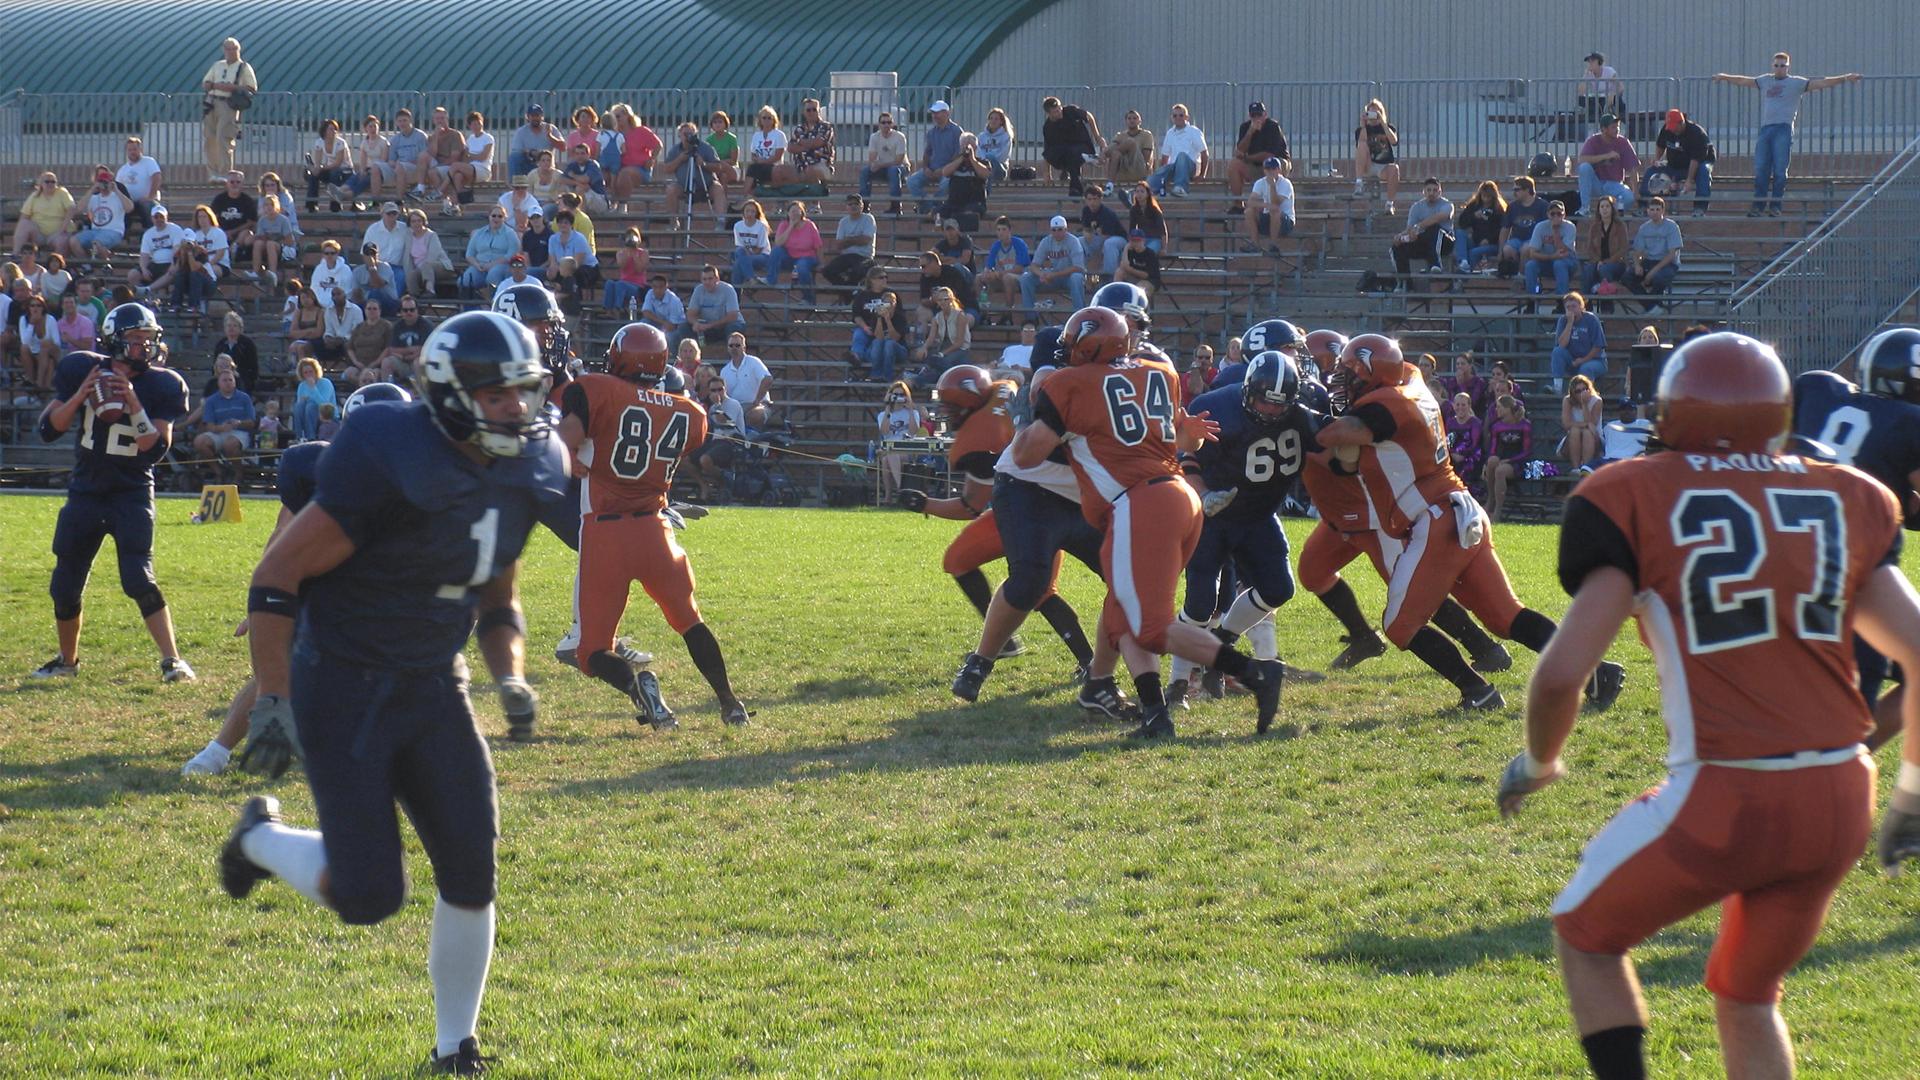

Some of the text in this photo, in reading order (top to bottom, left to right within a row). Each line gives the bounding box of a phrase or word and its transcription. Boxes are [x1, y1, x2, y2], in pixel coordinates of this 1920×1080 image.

[755, 148, 774, 158] NY
[757, 140, 763, 149] I
[424, 331, 460, 384] S
[1249, 326, 1267, 350] S
[637, 388, 674, 407] ELLIS
[1103, 370, 1177, 446] 64
[610, 405, 690, 483] 84
[1245, 429, 1301, 483] 69
[1685, 453, 1809, 474] PAQUIN
[200, 490, 226, 522] 50
[434, 508, 500, 600] 1
[1670, 487, 1849, 655] 27
